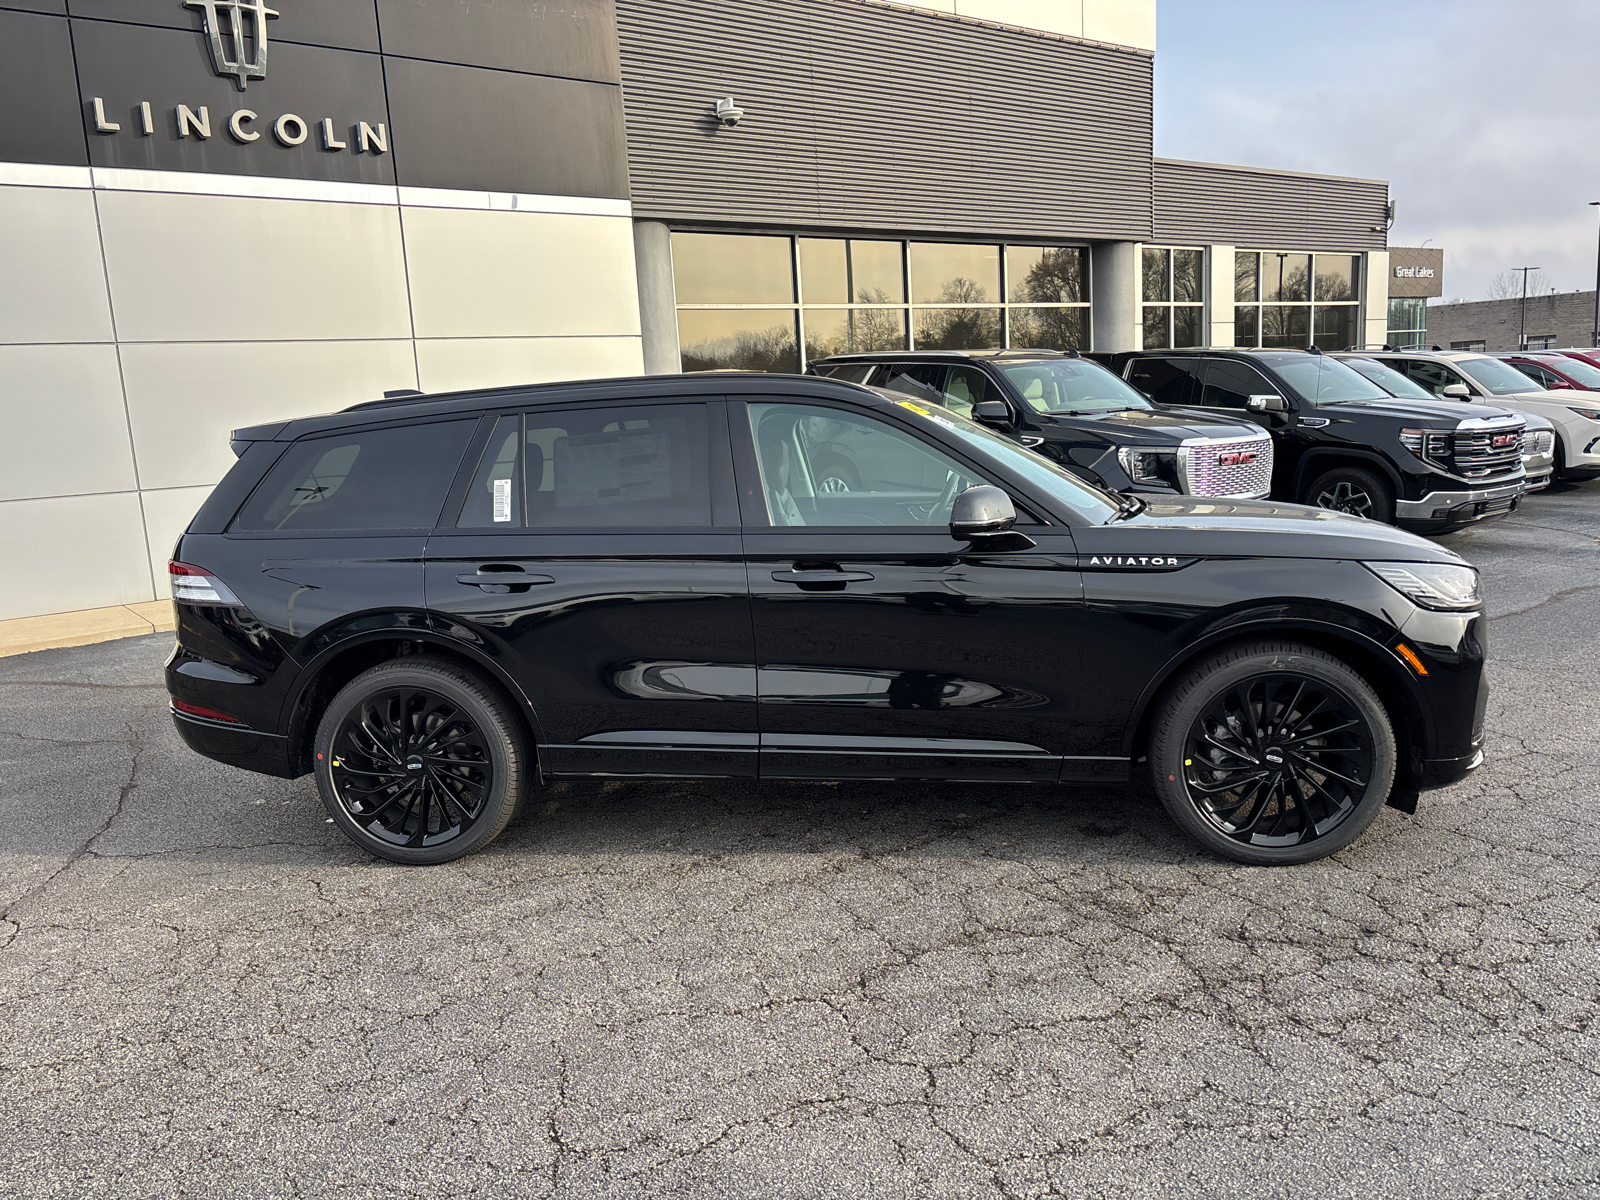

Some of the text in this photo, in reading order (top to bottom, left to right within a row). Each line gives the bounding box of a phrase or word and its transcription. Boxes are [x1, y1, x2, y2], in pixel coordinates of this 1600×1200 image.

[93, 97, 387, 152] LINCOLN
[1396, 266, 1434, 277] Great Lakes
[1493, 434, 1518, 446] GMC
[1221, 451, 1257, 465] GMC
[1090, 556, 1178, 566] AVIATOR
